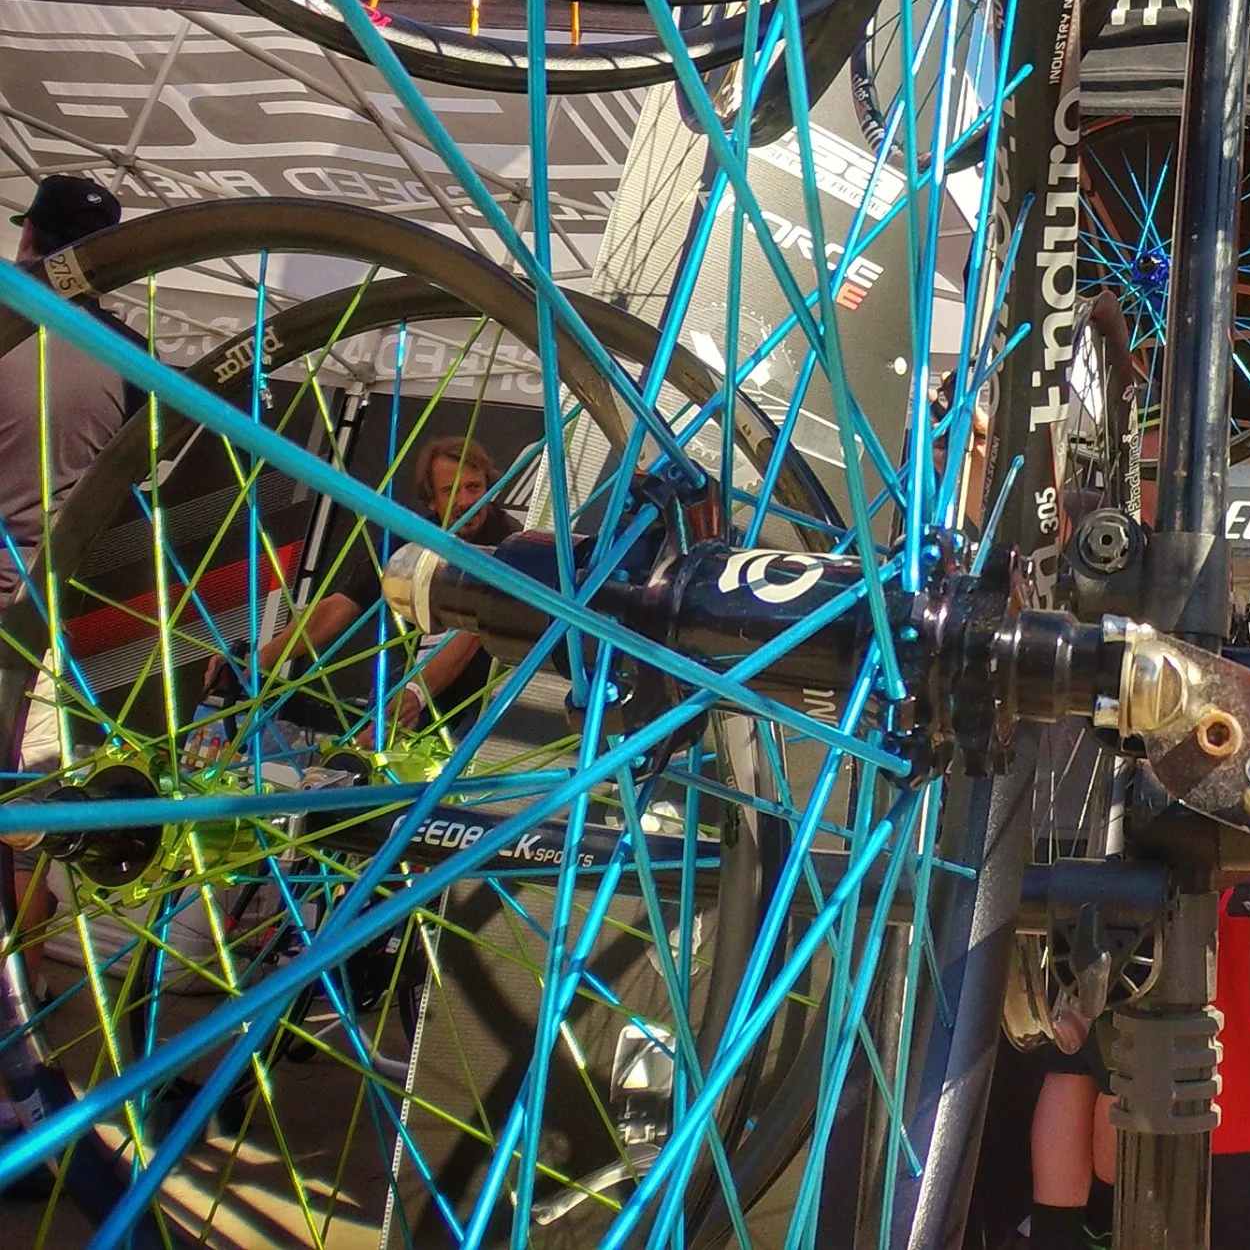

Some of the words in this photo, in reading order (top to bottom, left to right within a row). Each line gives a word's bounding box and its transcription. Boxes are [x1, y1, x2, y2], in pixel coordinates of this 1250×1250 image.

[1049, 8, 1071, 86] INDUSTRY
[1034, 486, 1059, 535] 305
[389, 814, 541, 860] EEDBK
[533, 846, 595, 868] SPOTS
